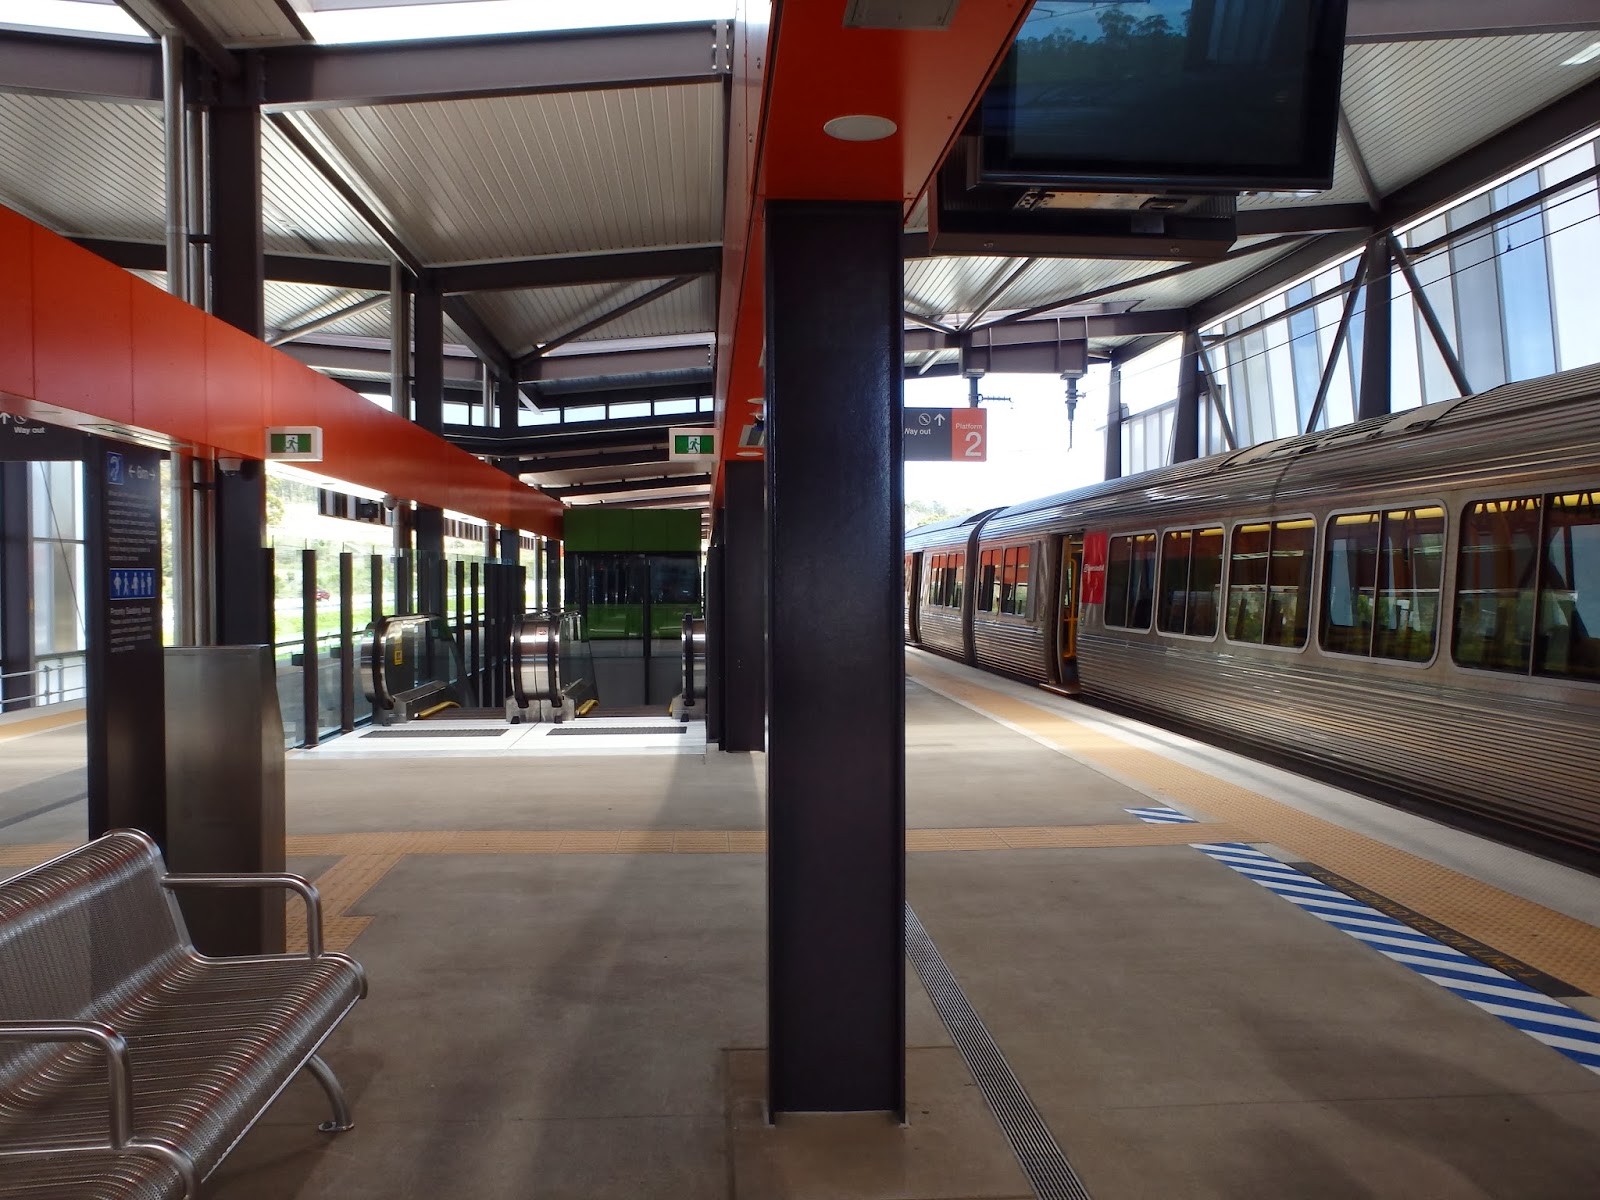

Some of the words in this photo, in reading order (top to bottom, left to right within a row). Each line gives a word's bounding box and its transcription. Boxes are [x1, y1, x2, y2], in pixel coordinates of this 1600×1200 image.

[13, 426, 31, 435] Way
[31, 426, 46, 434] out
[919, 427, 931, 435] out
[965, 431, 982, 457] 2
[1350, 888, 1410, 916] BEHIND
[1404, 915, 1480, 948] YELLOW
[1470, 949, 1525, 970] LINE
